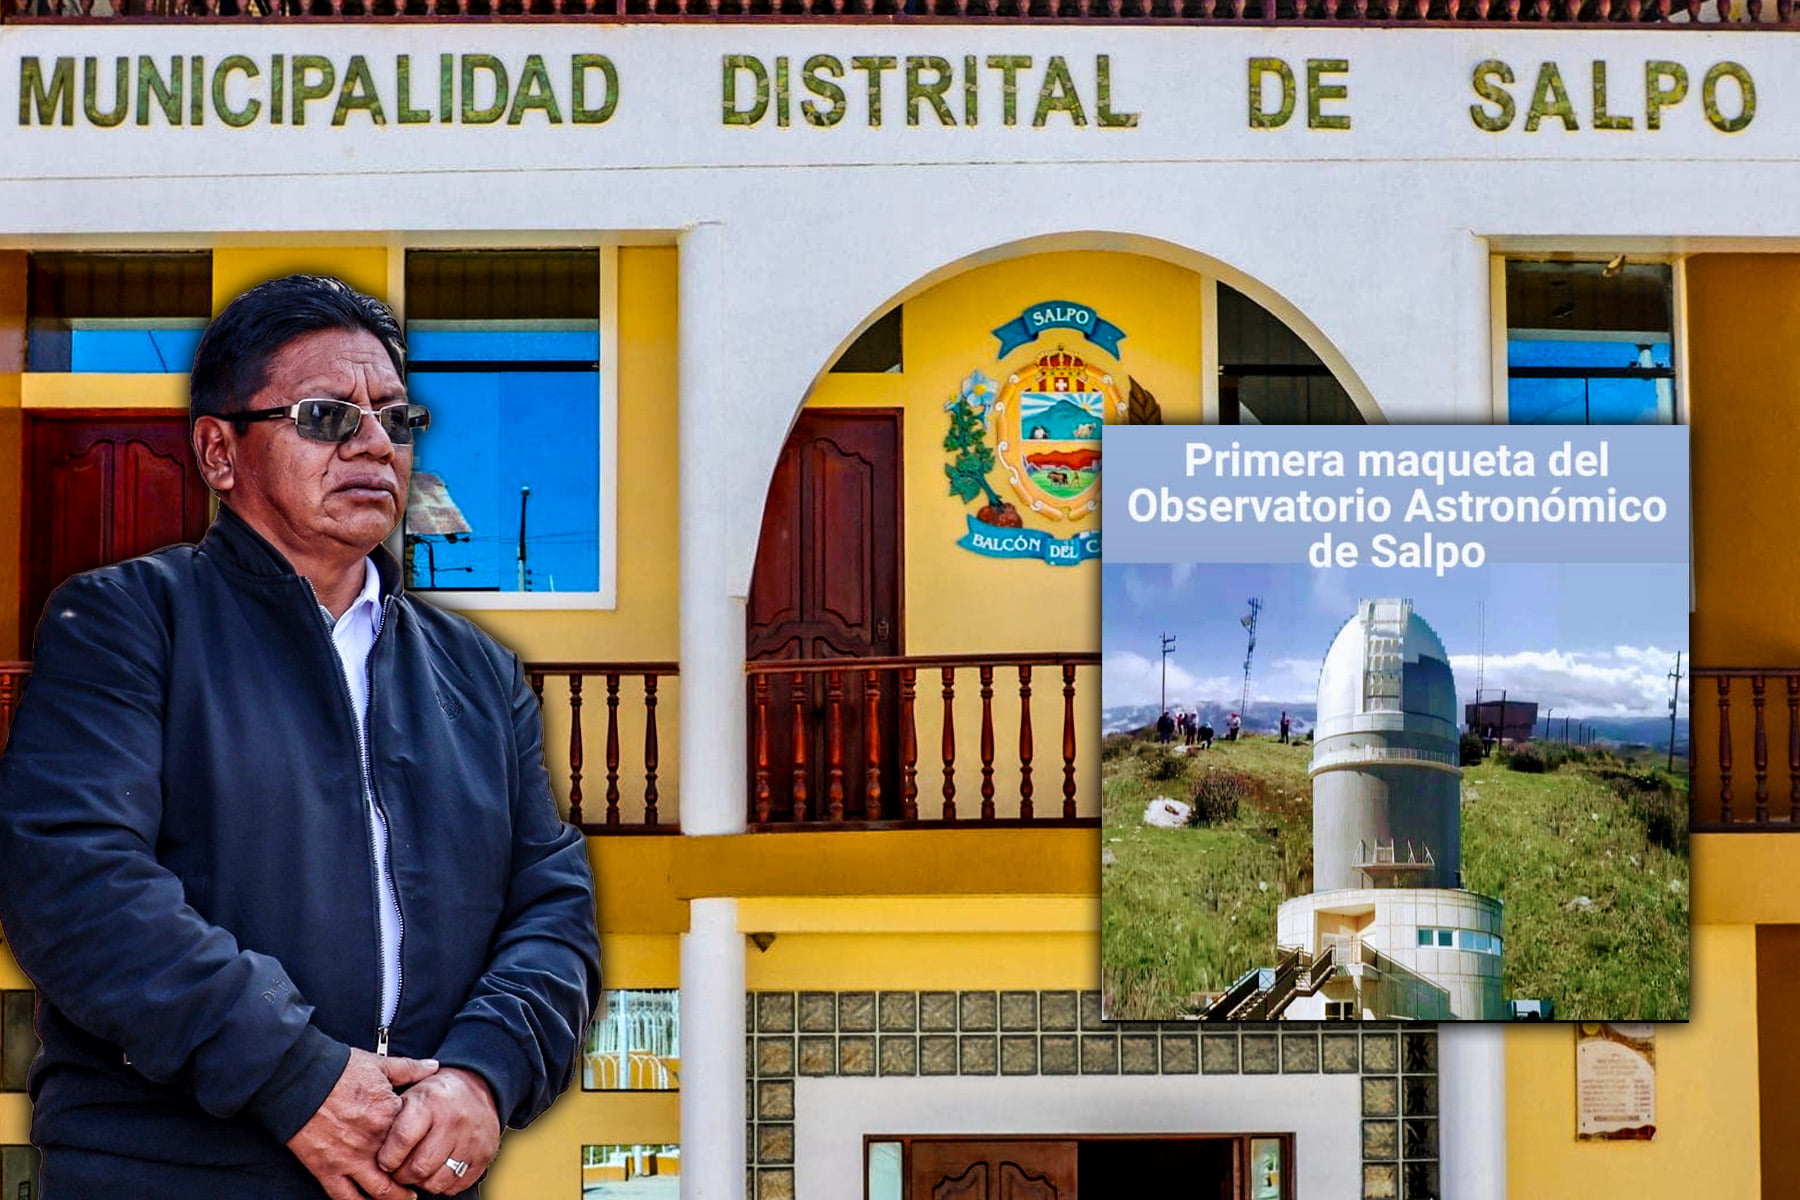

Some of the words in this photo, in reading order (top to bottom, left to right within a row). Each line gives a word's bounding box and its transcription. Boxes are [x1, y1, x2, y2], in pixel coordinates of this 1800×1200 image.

[18, 53, 619, 128] MUNICIPALIDAD
[722, 54, 1140, 128] DISTRITAL
[1248, 57, 1351, 130] DE
[1470, 59, 1757, 133] SALPO
[1032, 307, 1090, 326] SALPO
[972, 533, 1041, 552] BALCÓN
[1050, 545, 1080, 559] DEL
